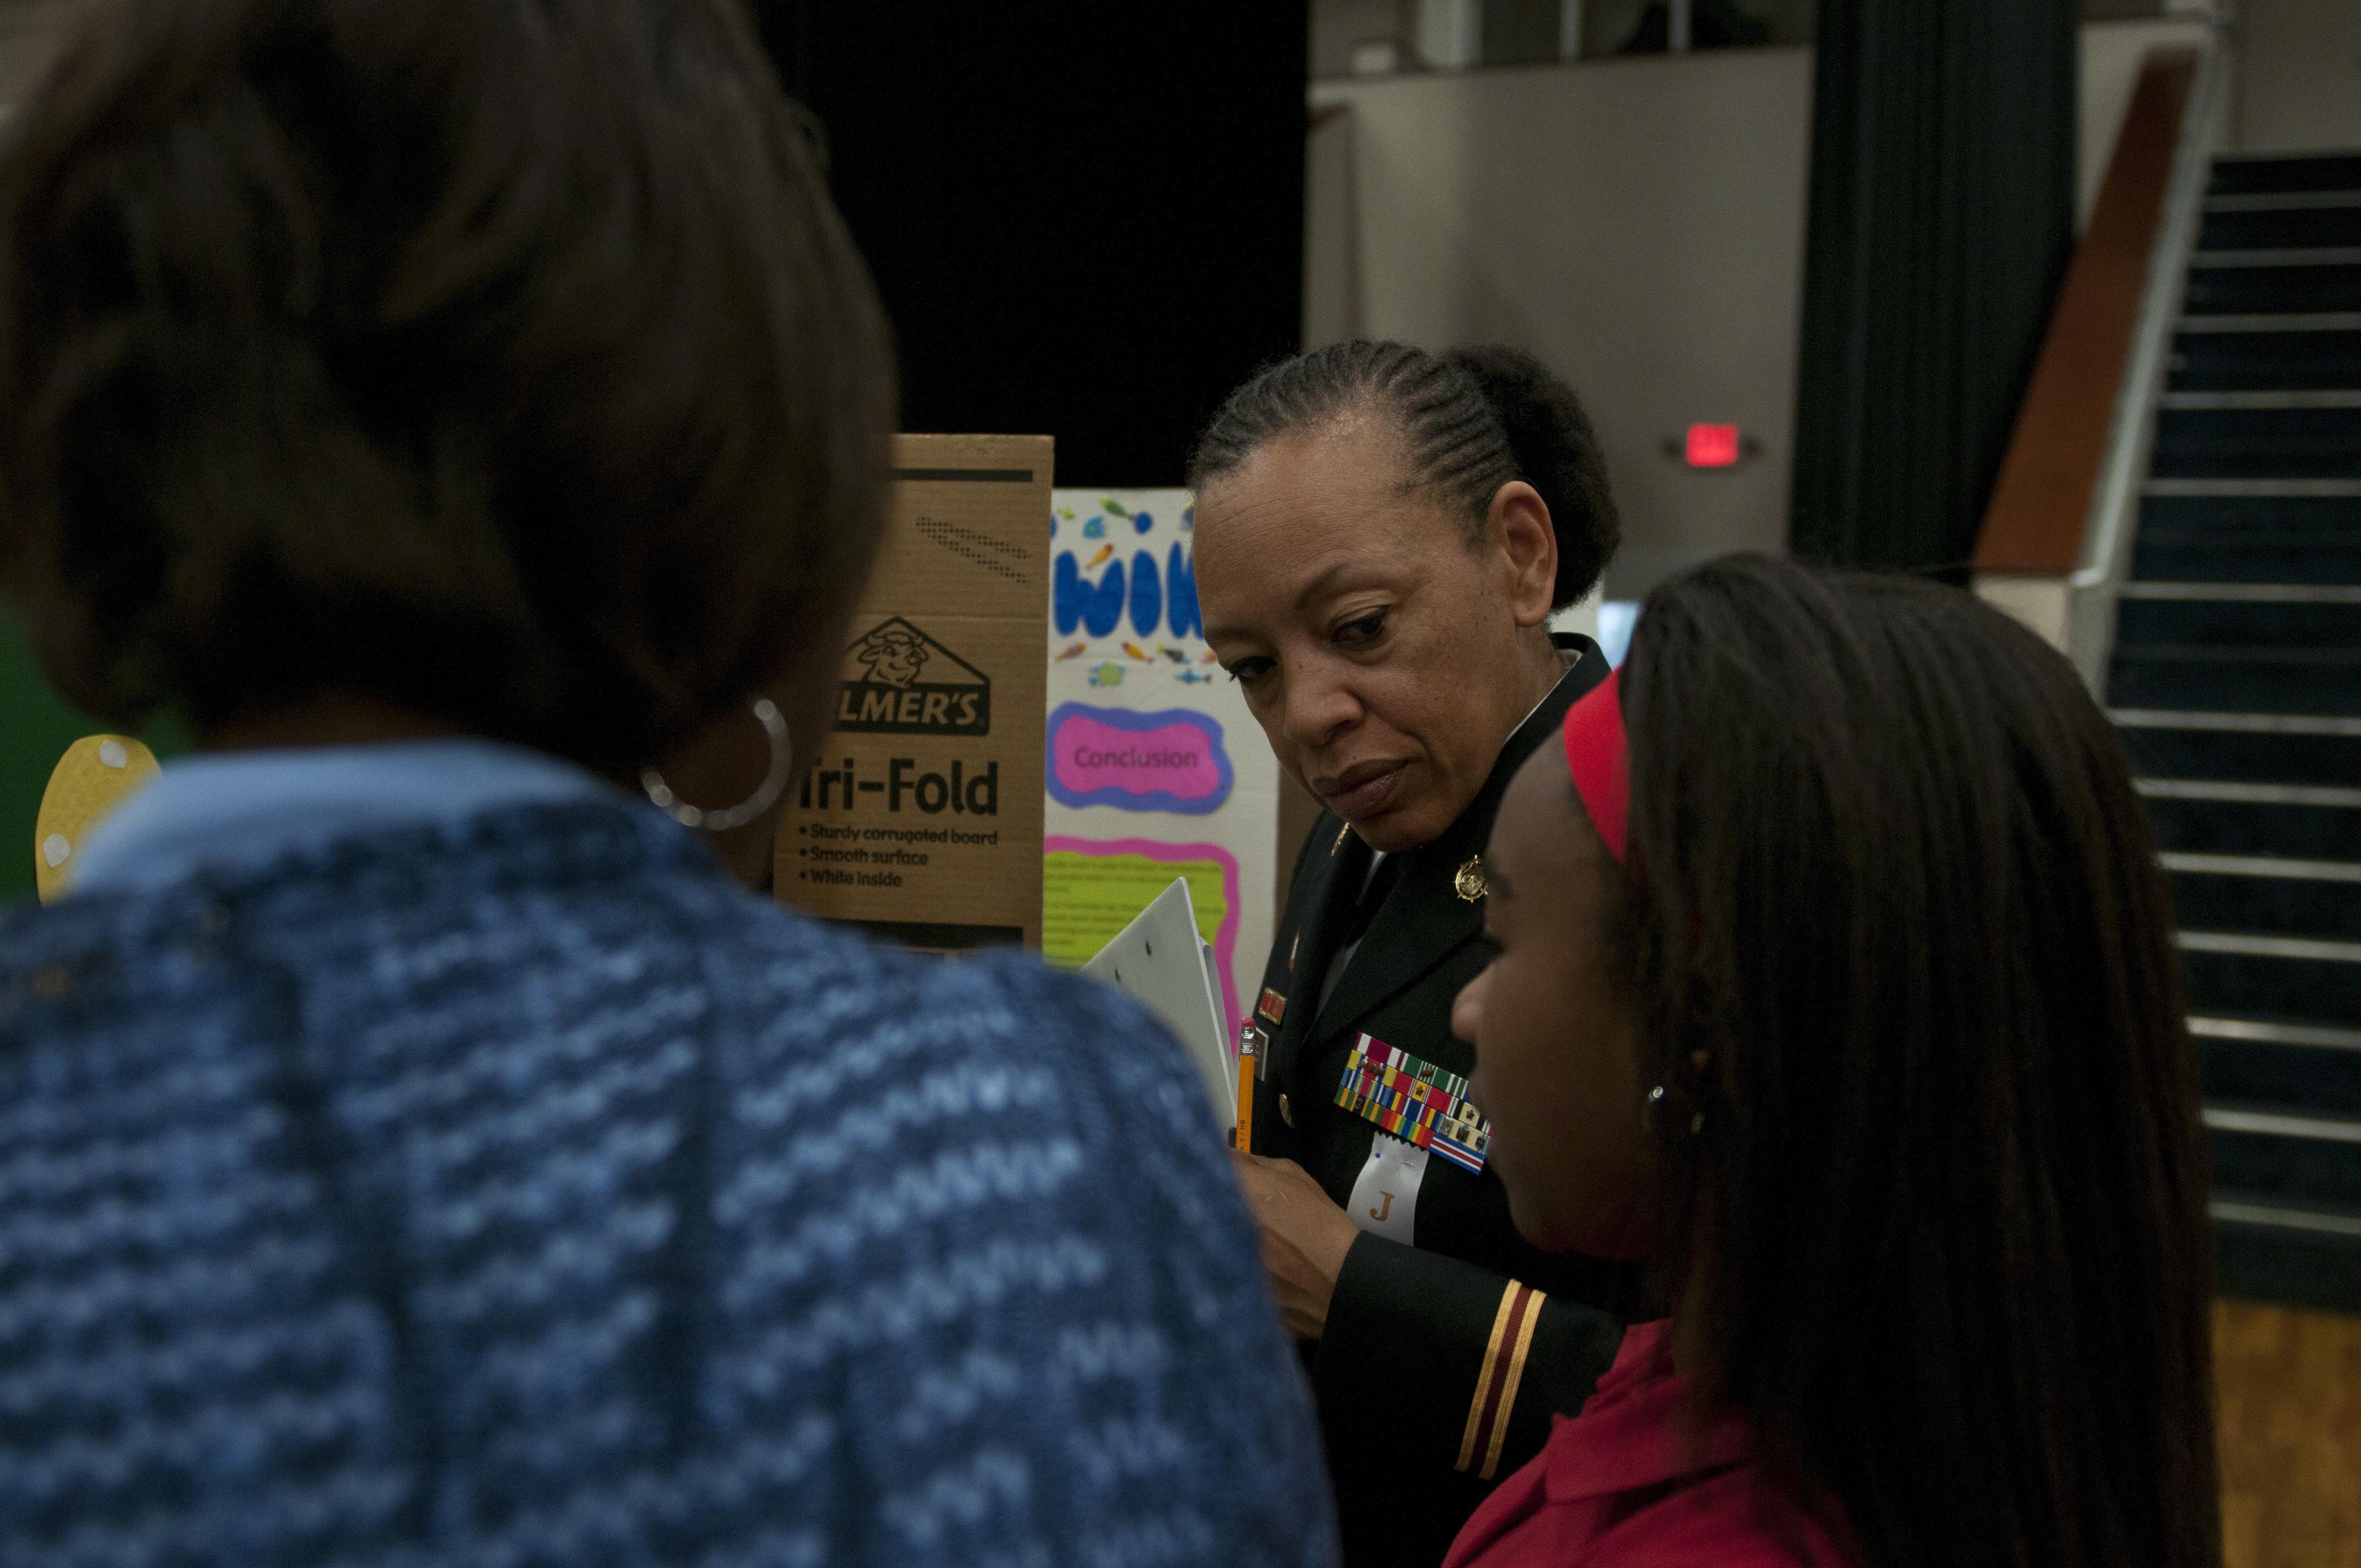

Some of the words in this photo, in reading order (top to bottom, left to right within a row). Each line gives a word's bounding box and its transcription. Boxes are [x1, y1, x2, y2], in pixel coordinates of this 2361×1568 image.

[837, 690, 978, 725] LMER'S
[1075, 747, 1198, 768] Conclusion
[810, 824, 859, 841] Sturdy
[863, 828, 948, 844] corrugated
[951, 830, 998, 845] board
[810, 846, 868, 862] Smooth
[871, 850, 929, 865] surface
[810, 869, 853, 885] White
[857, 871, 902, 886] inside
[1369, 1191, 1395, 1222] J
